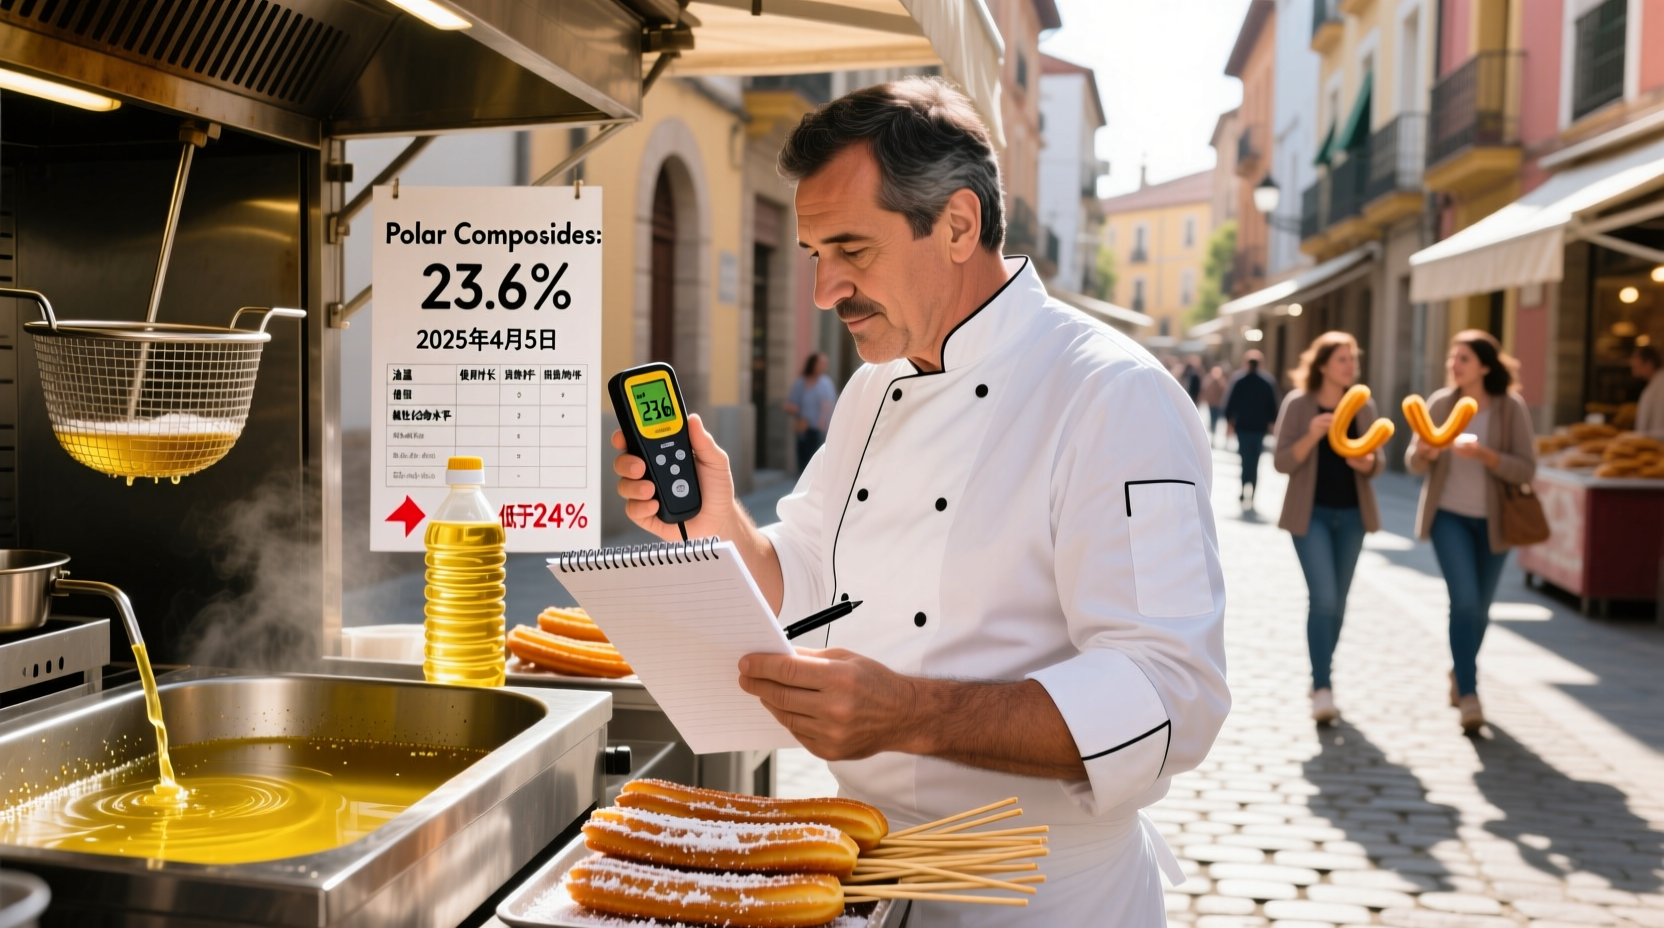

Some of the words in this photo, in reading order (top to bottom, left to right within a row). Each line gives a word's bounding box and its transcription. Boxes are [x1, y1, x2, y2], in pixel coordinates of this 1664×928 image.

[386, 221, 447, 245] Polar
[454, 221, 602, 253] Composides:
[421, 262, 572, 310] 23.6%
[416, 327, 556, 351] 2025年4月5日
[498, 503, 588, 529] 低于24%
